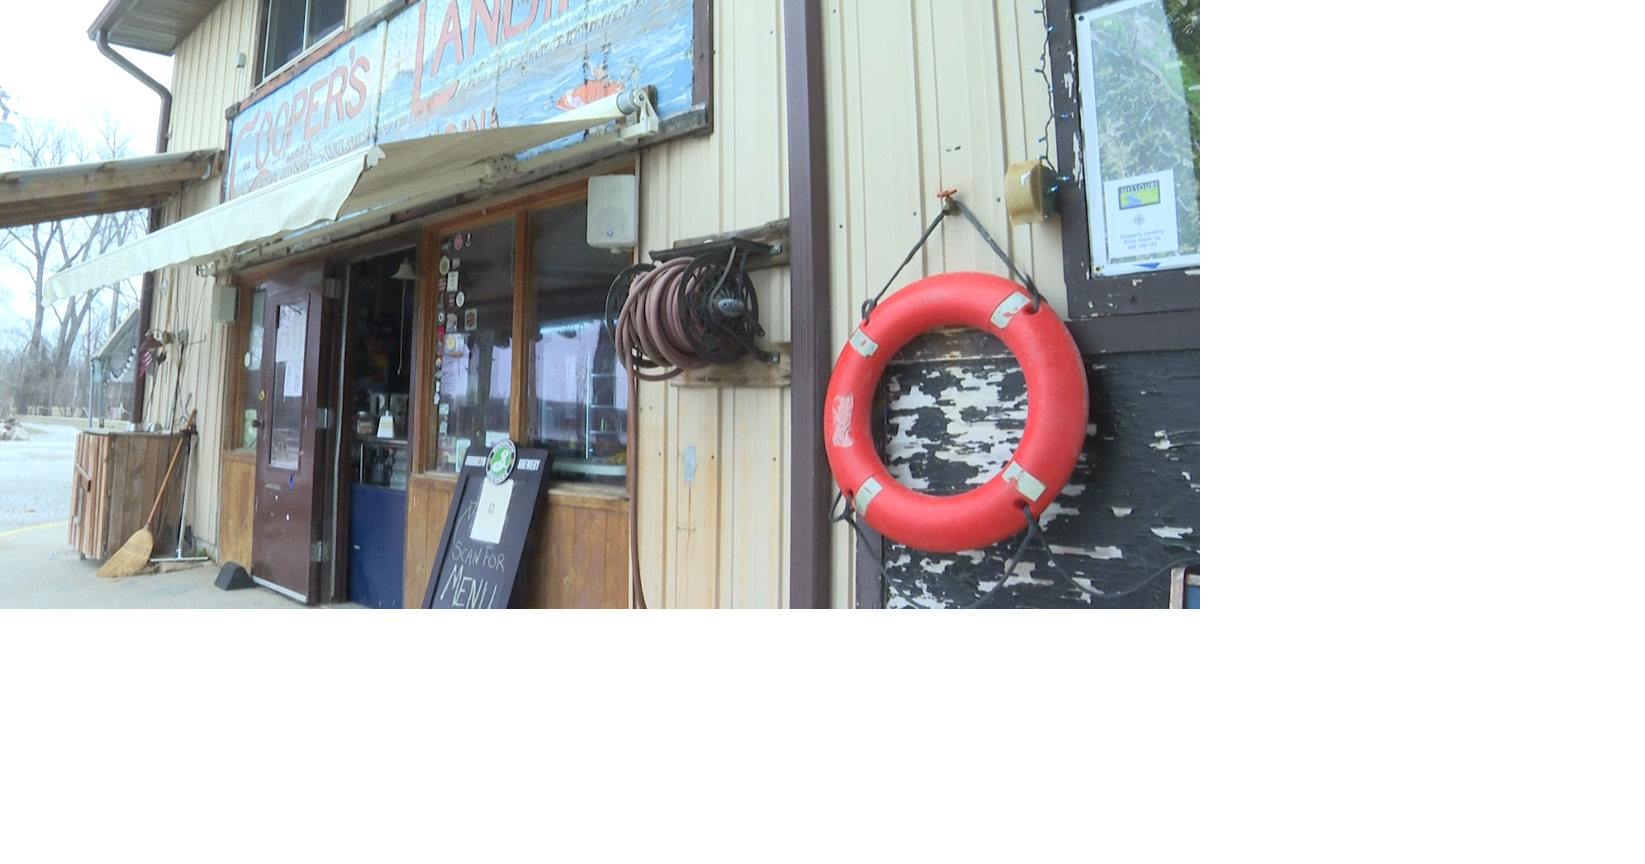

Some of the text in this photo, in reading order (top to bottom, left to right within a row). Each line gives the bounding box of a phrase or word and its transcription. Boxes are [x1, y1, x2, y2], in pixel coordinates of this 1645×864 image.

[229, 46, 370, 199] COOPER'S
[1121, 182, 1157, 193] MISSOURI
[451, 541, 482, 565] SCAN
[440, 564, 498, 609] MENU
